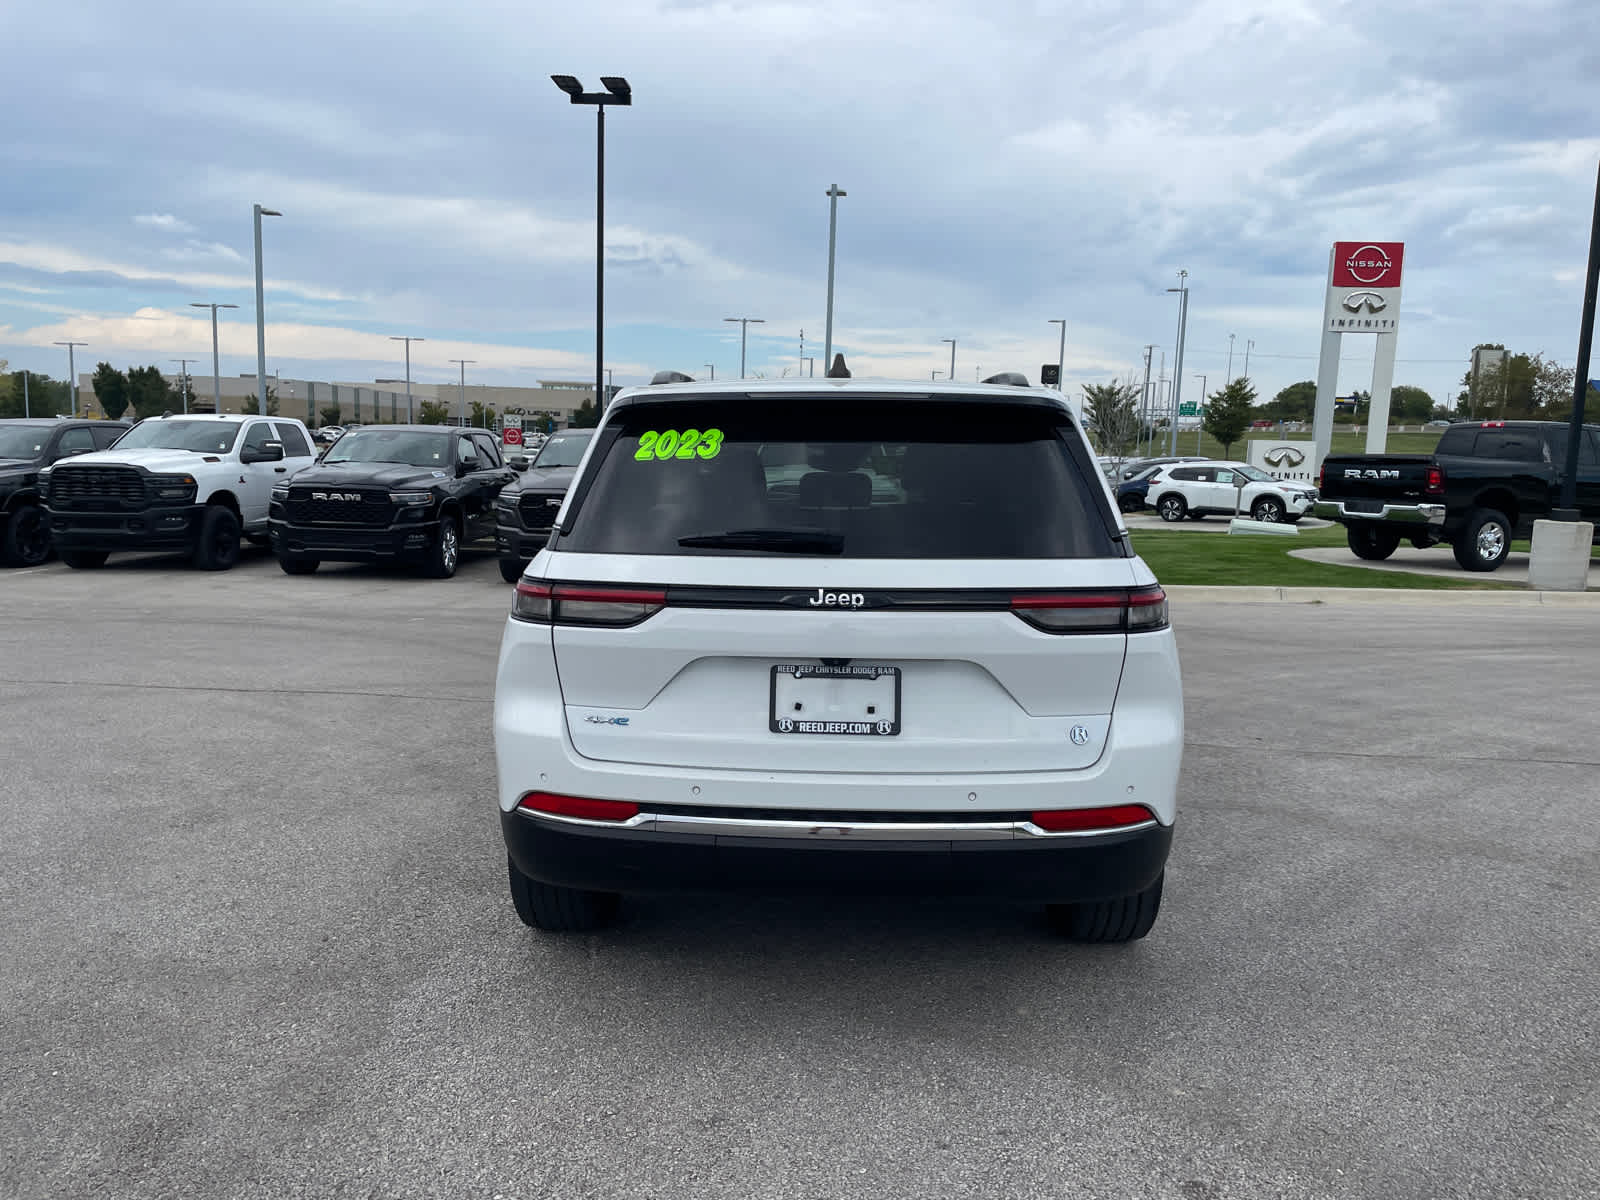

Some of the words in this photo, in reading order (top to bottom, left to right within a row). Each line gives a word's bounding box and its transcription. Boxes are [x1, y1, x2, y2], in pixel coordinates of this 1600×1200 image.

[1346, 260, 1392, 268] NISSAN
[1331, 319, 1395, 328] INFINITI
[634, 428, 725, 461] 2023
[1264, 471, 1311, 480] FINITI
[1344, 469, 1400, 479] RAM
[312, 492, 361, 501] RAM
[809, 588, 865, 610] Jeep
[777, 665, 796, 673] REED
[797, 665, 814, 673] JEEP
[815, 666, 851, 674] CHRYSLER
[852, 666, 877, 675] DODGE
[877, 667, 895, 675] RAM
[799, 722, 871, 734] REEDJEEP.COM
